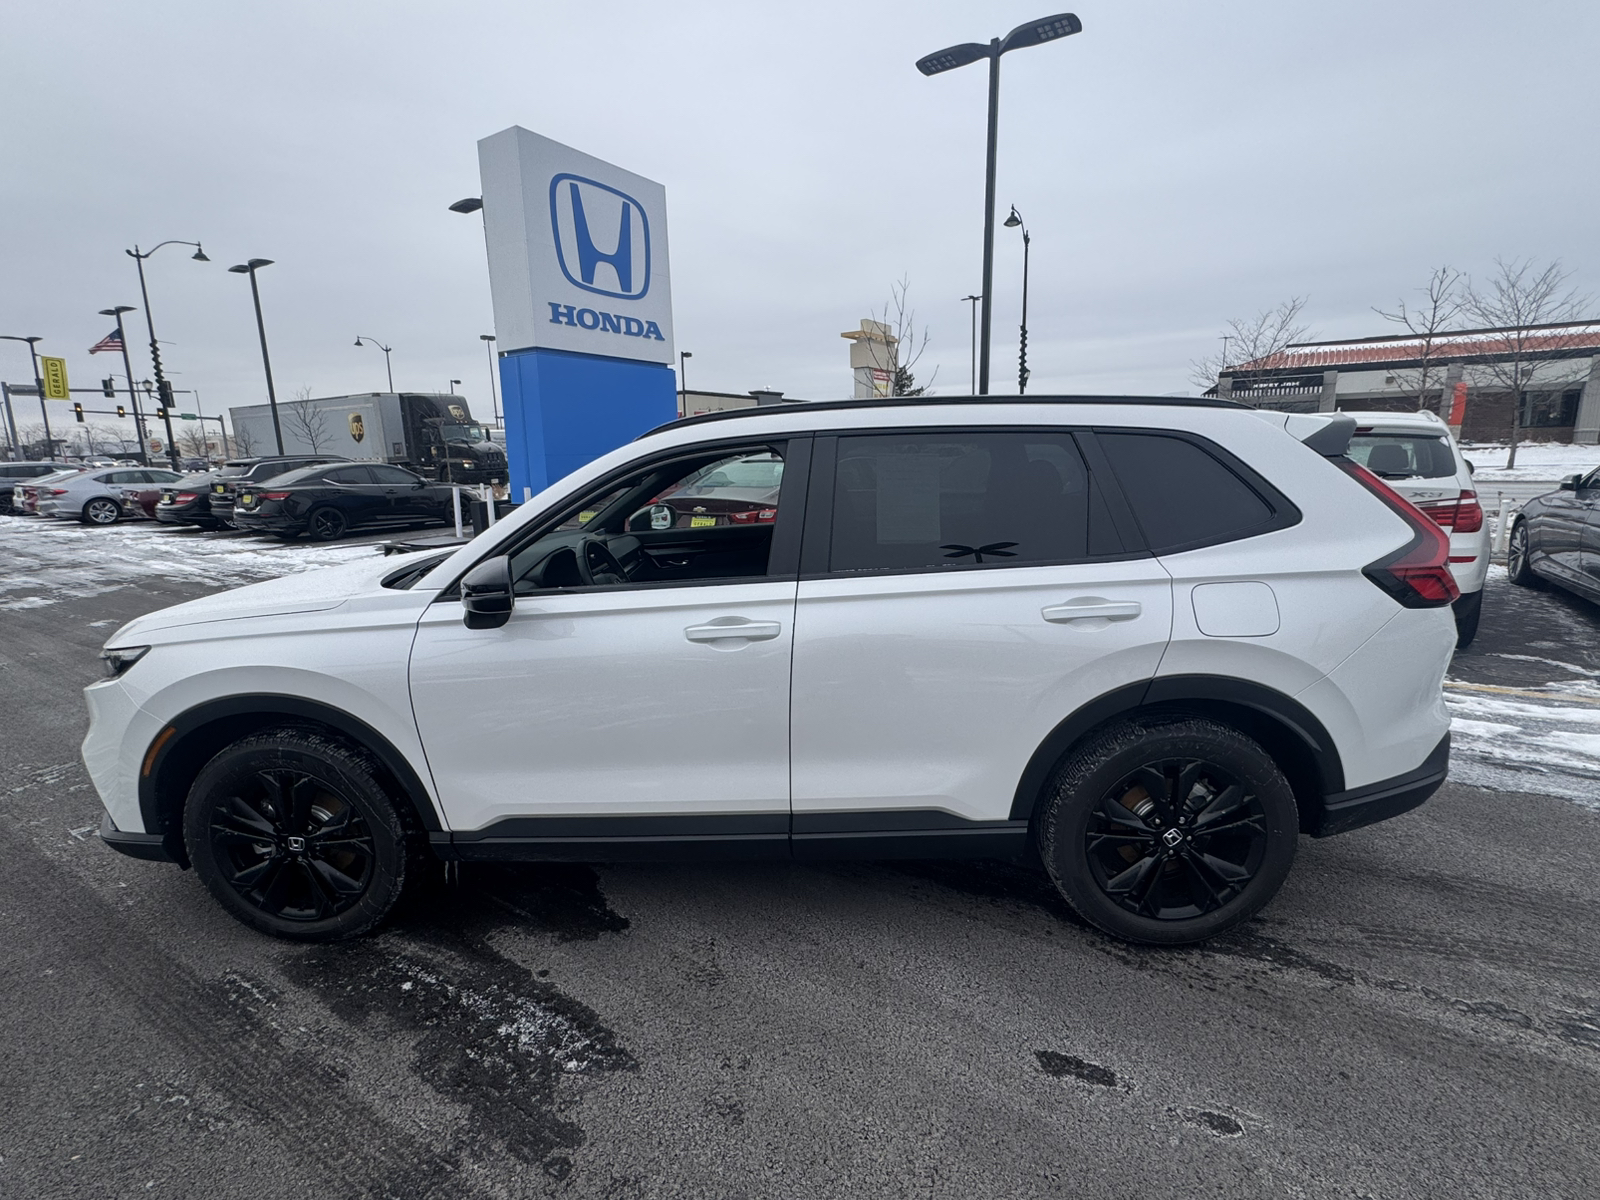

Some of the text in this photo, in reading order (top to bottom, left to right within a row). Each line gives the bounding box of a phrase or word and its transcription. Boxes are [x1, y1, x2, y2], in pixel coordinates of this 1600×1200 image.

[547, 301, 665, 341] HONDA
[50, 362, 61, 394] GERALD
[351, 421, 364, 440] ups
